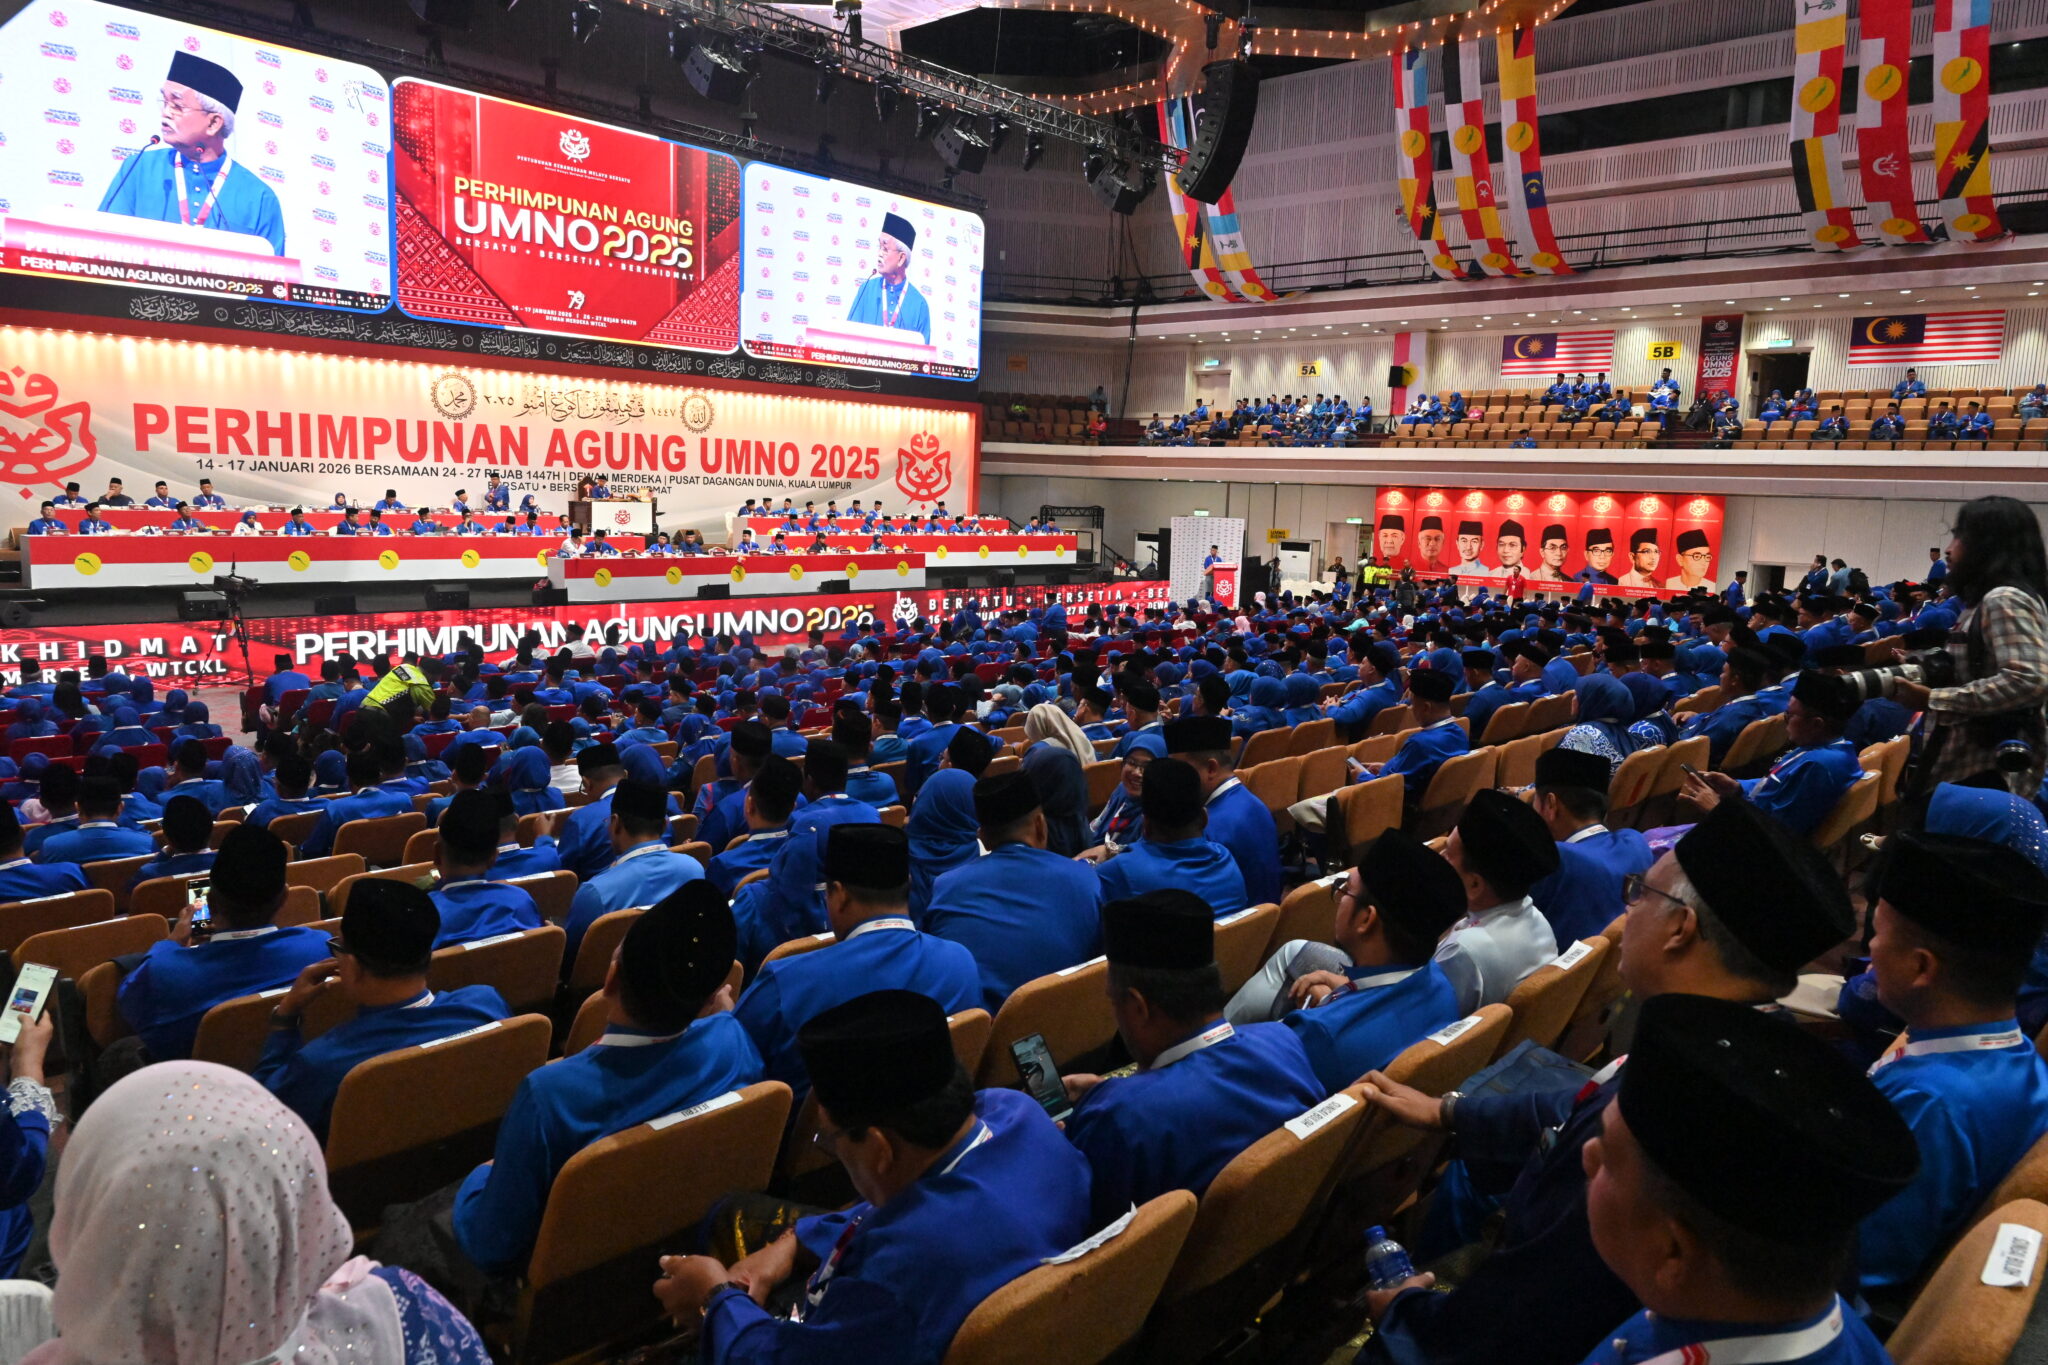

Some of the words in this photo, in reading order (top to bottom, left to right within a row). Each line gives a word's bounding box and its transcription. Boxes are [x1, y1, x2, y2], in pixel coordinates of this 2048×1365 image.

[454, 176, 618, 223] PERHIMPUNAN
[623, 209, 693, 237] AGUNG
[454, 196, 600, 254] UMNO
[602, 224, 694, 270] 2025
[455, 236, 518, 254] BERSATU
[539, 249, 601, 268] BERSETIA
[621, 262, 695, 282] BERKHIDMAT
[20, 255, 125, 279] PERHIMPUNAN
[126, 269, 175, 285] AGUNG
[175, 274, 227, 291] UMNO
[292, 287, 341, 299] BERSATU
[532, 308, 557, 316] JANUARI
[545, 315, 565, 323] DEWAN
[811, 351, 857, 365] PERHIMPUNAN
[857, 357, 879, 367] AGUNG
[879, 360, 902, 369] UMNO
[1653, 346, 1674, 358] 5B
[1301, 365, 1317, 375] 5A
[1702, 367, 1732, 378] 2025
[1703, 361, 1733, 369] UMNO
[133, 402, 529, 467] PERHIMPUNAN
[544, 428, 687, 473] AGUNG
[700, 437, 800, 475] UMNO
[810, 443, 880, 479] 2025
[196, 458, 213, 471] 14
[228, 459, 245, 471] 17
[249, 460, 314, 474] JANUARI
[318, 462, 351, 475] 2026
[354, 464, 439, 477] BERSAMAAN
[442, 466, 457, 478] 24
[467, 467, 481, 478] 27
[526, 470, 560, 481] 1447H
[611, 473, 662, 484] MERDEKA
[669, 475, 700, 486] PUSAT
[702, 477, 753, 487] DAGANGAN
[756, 478, 786, 489] DUNIA,
[788, 480, 816, 489] KUALA
[818, 480, 852, 490] LUMPUR
[487, 481, 540, 491] BRSATU
[610, 484, 672, 495] BERKHMAT
[929, 594, 1013, 611] BERATU
[1044, 589, 1122, 605] ERSETIA
[929, 614, 940, 625] 16
[1066, 606, 1076, 615] 27
[295, 620, 577, 665] PERHIMPUNAN
[581, 612, 694, 645] AGUNG
[696, 607, 804, 637] UMNO
[806, 604, 875, 632] 2025
[0, 634, 227, 663] KHIDMAT
[2, 664, 135, 686] MREA,
[147, 659, 227, 677] WTCKL
